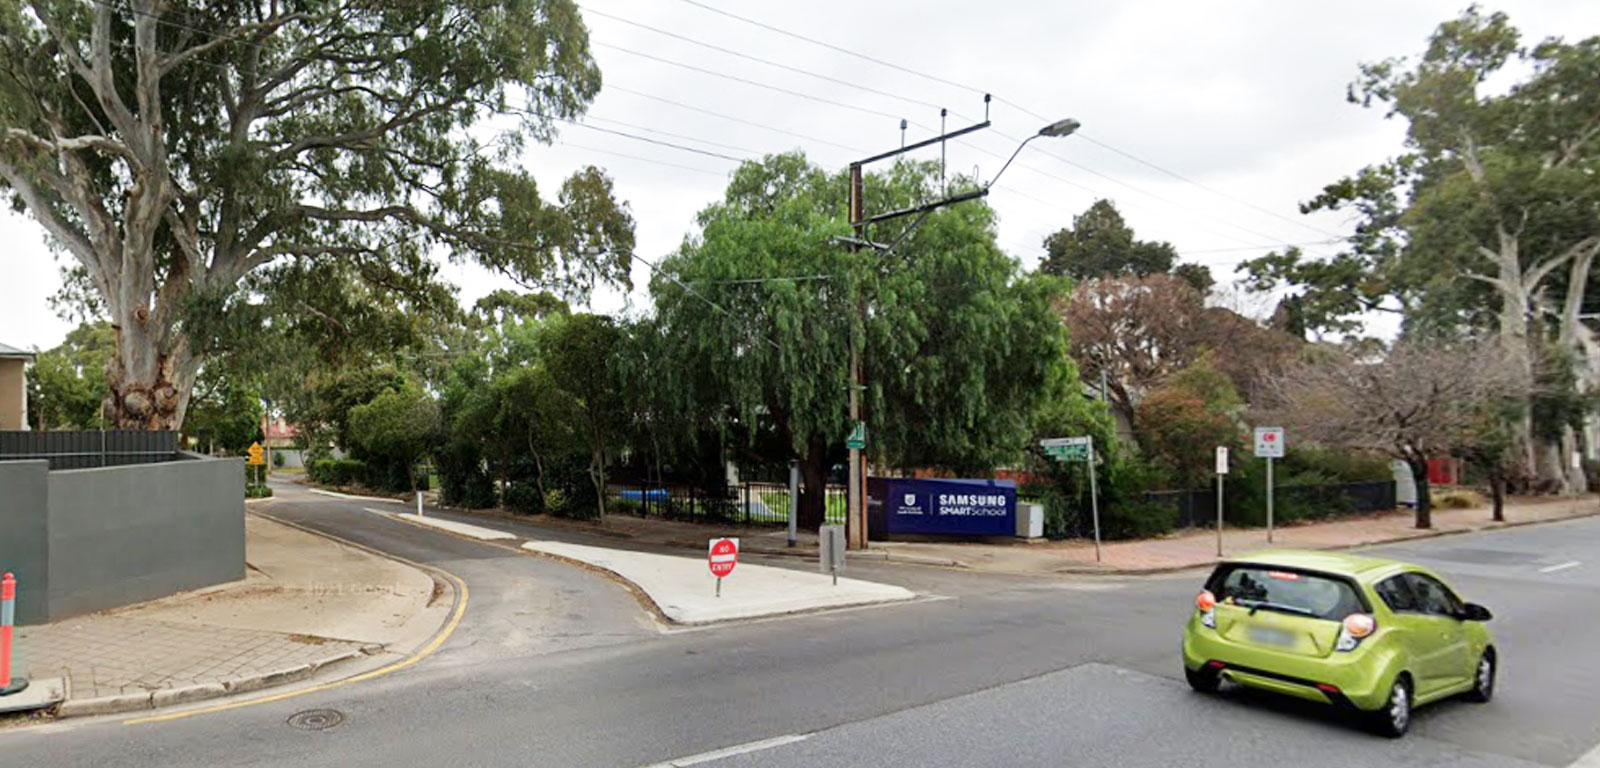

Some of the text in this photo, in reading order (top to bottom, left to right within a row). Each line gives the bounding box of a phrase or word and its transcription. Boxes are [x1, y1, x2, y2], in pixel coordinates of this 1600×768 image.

[939, 494, 1006, 506] SAMSUNG
[939, 506, 1007, 516] SMARTSchool
[712, 562, 733, 572] ENTRY
